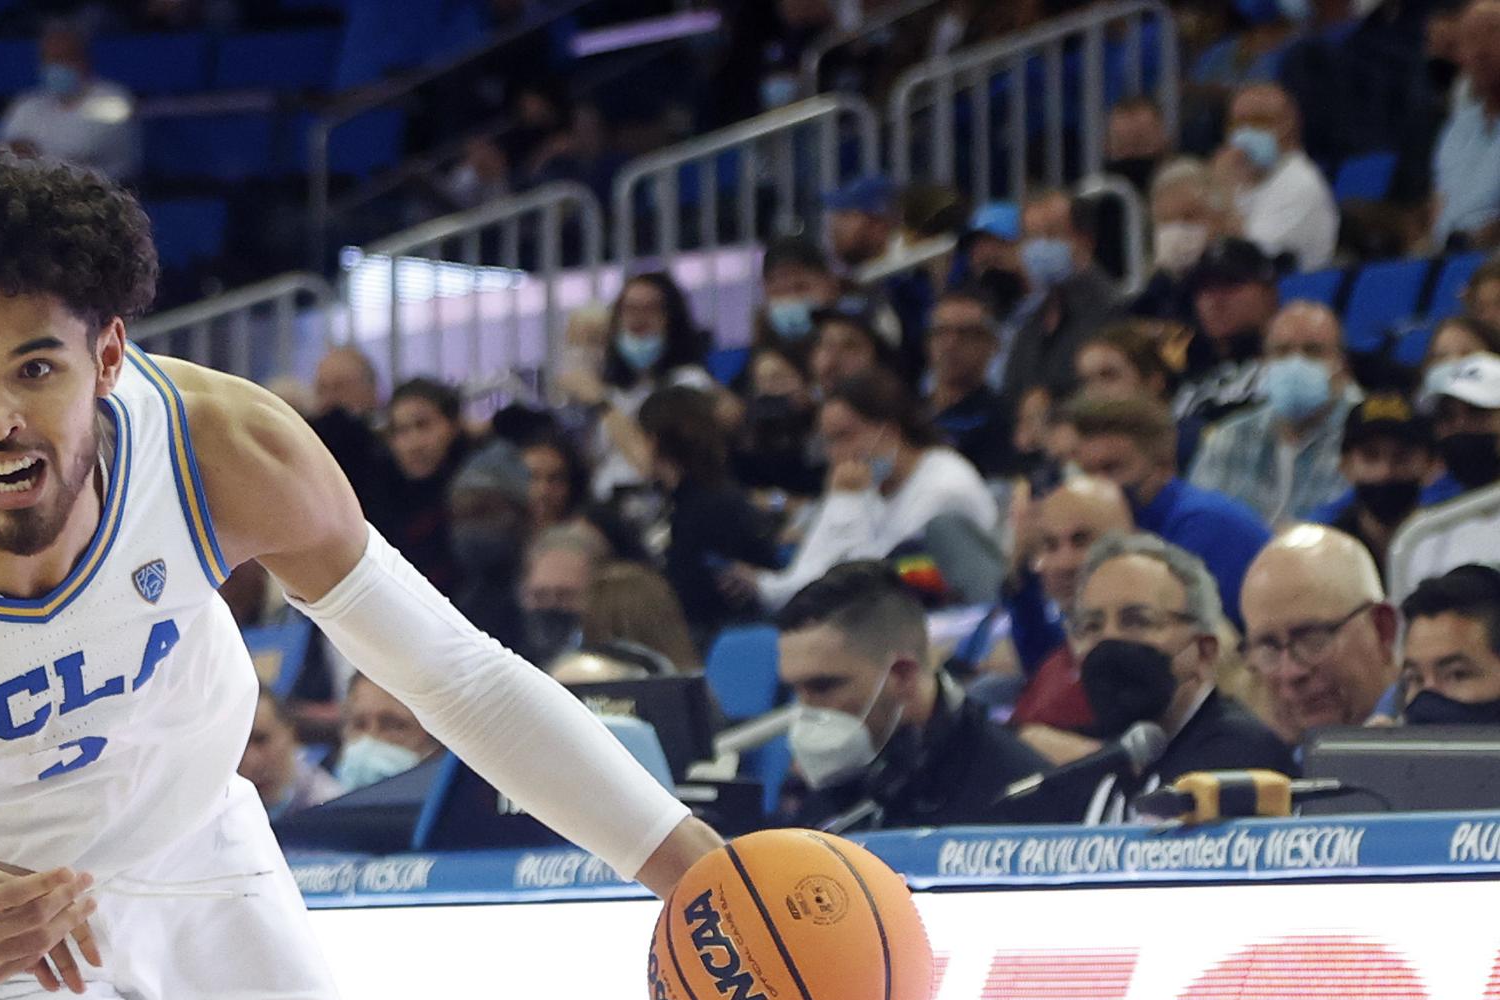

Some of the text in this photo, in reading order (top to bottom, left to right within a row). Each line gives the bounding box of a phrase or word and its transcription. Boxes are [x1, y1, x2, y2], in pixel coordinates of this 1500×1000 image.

[938, 826, 1367, 876] PAULEY PAVILION presented by WESCOM
[1450, 822, 1500, 862] PAU
